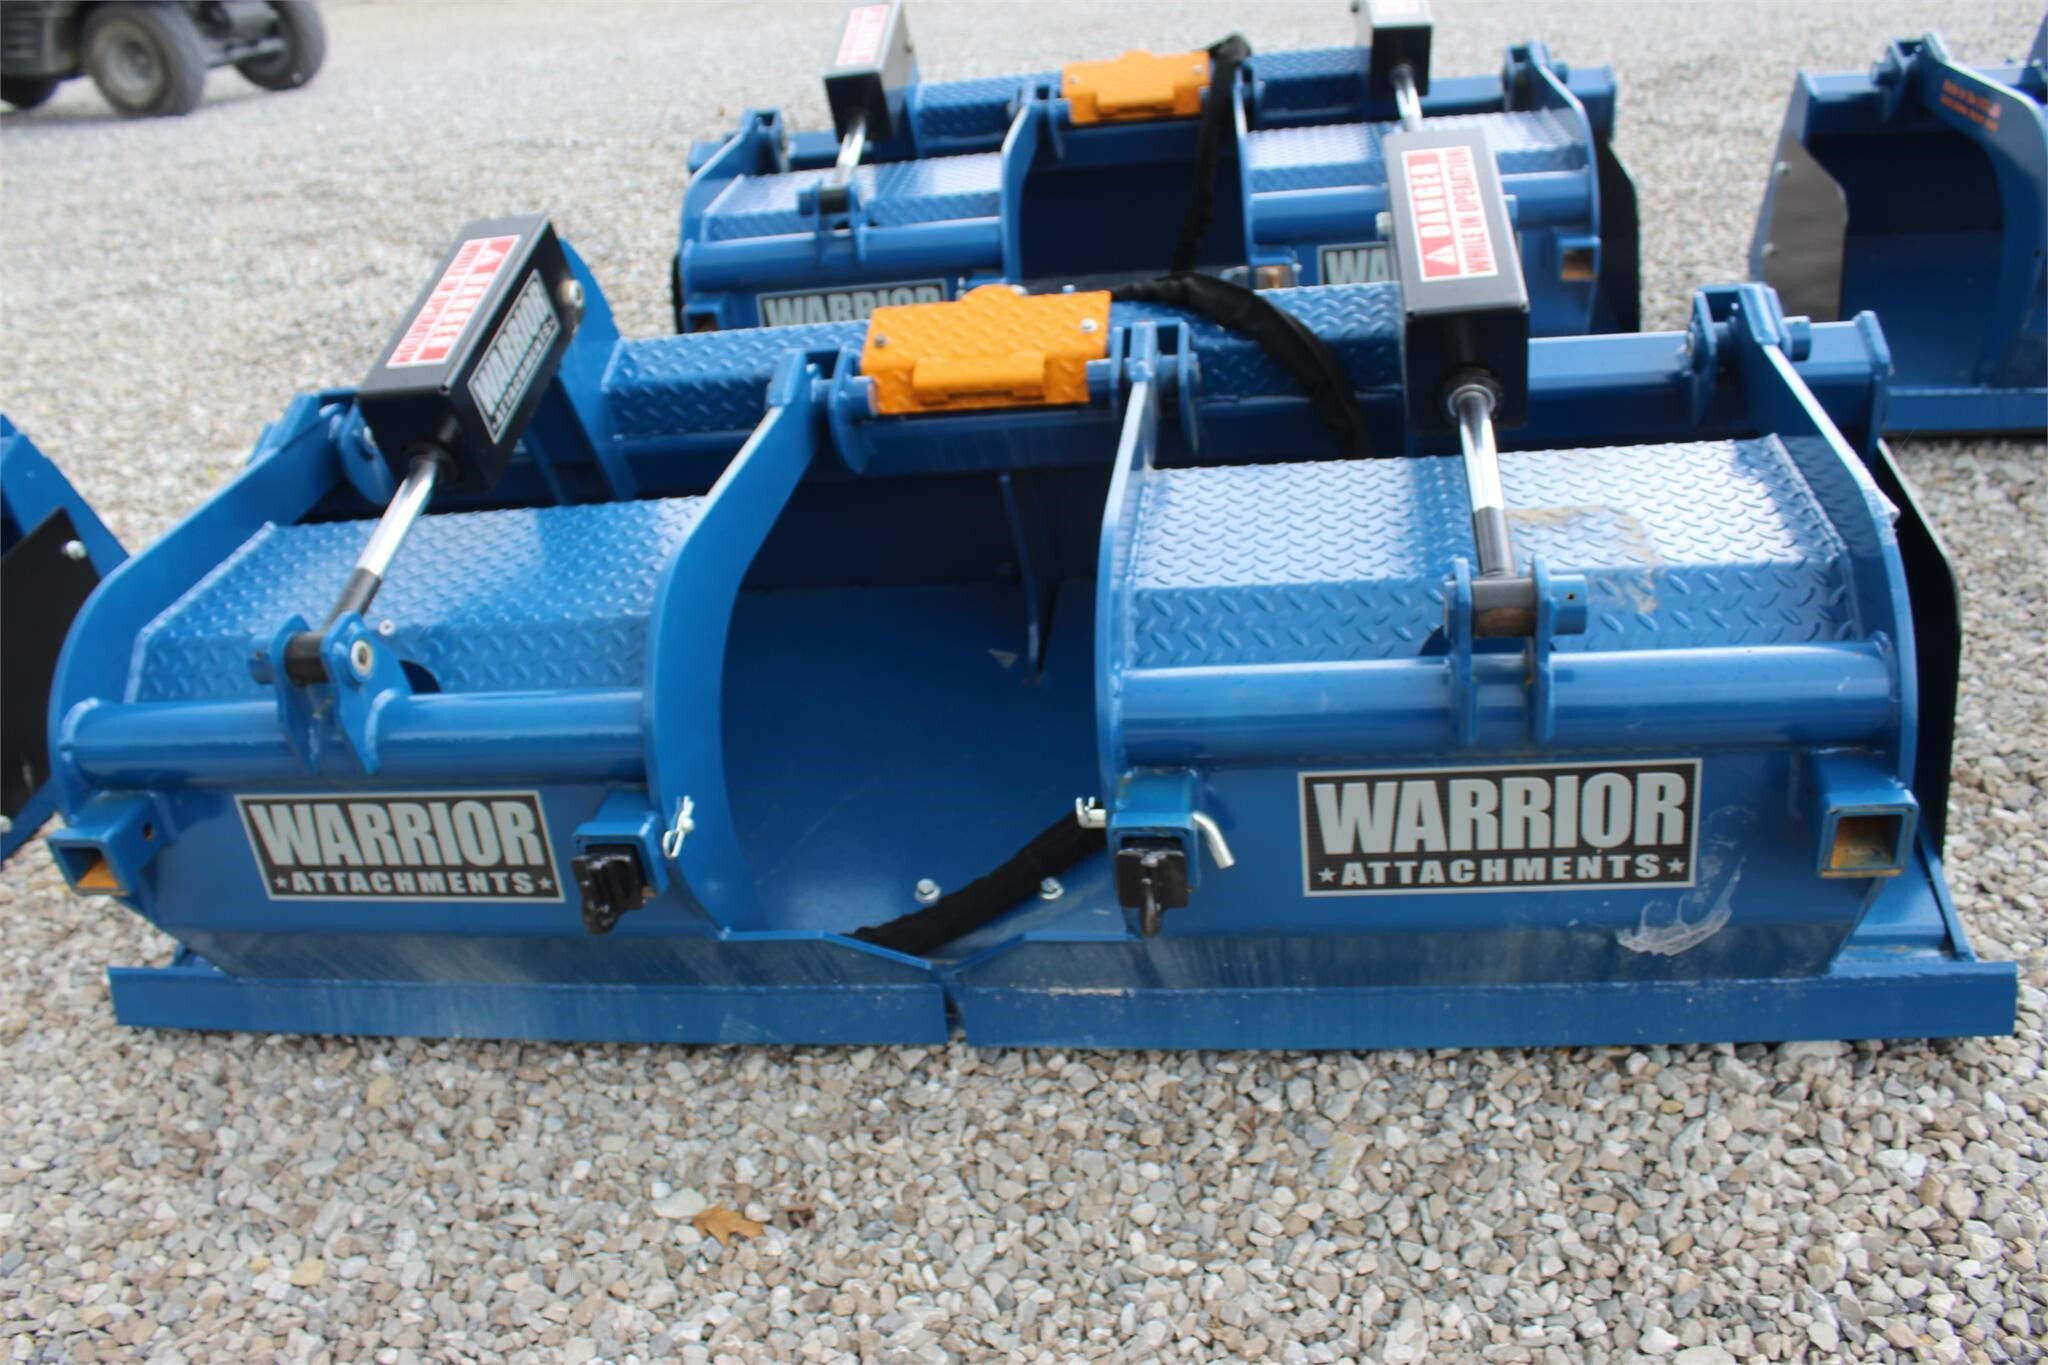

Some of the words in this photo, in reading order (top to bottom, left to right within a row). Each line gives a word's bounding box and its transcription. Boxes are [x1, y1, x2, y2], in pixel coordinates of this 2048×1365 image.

[473, 281, 551, 417] WARRIOR
[248, 800, 546, 867] WARRIOR
[1313, 772, 1687, 855] WARRIOR
[292, 870, 535, 894] ATTACHMENTS
[1341, 853, 1661, 886] ATTACHMENTS
